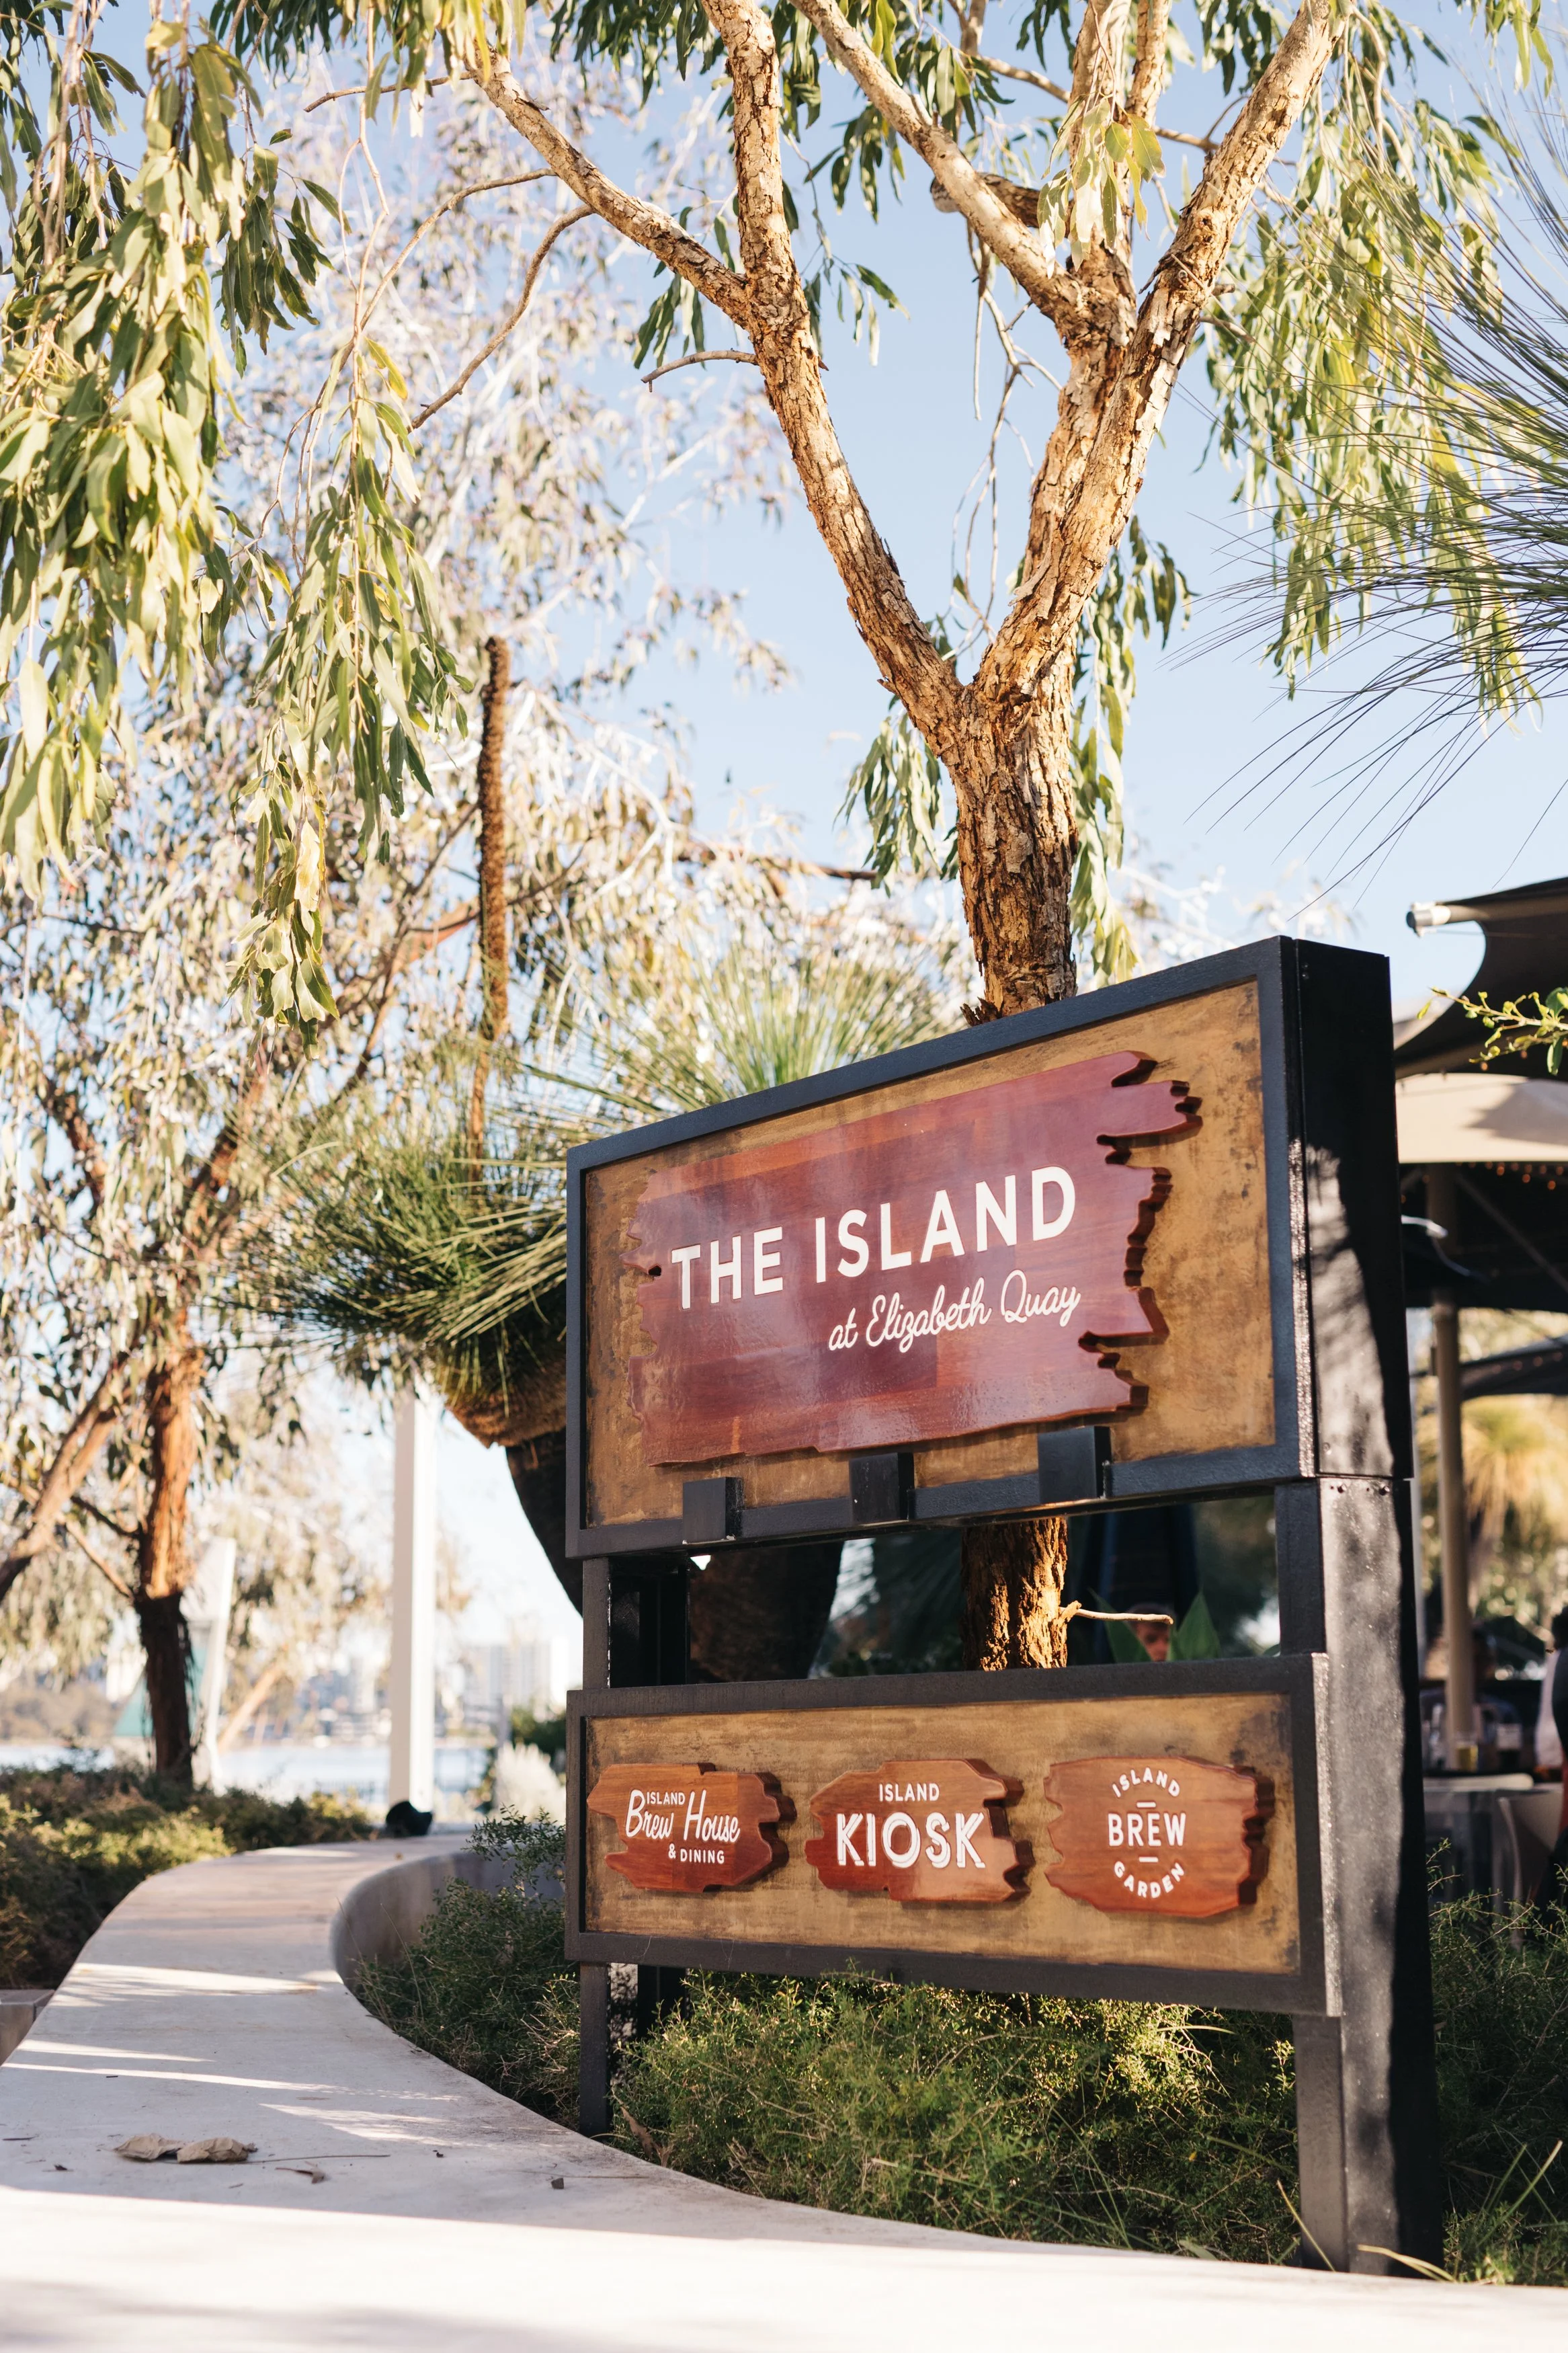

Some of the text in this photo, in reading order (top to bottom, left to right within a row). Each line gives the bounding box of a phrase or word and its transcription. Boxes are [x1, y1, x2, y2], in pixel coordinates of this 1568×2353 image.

[671, 1166, 1076, 1310] THE ISLAND
[828, 1269, 1081, 1353] at Elizabeth Quay
[646, 1791, 686, 1805] ISLAND
[878, 1783, 940, 1802] ISLAND
[1112, 1767, 1180, 1798] ISLAND
[625, 1789, 741, 1843] Brew House
[1108, 1812, 1186, 1847] BREW
[668, 1843, 725, 1864] & DINING
[837, 1811, 986, 1869] KIOSK
[1114, 1861, 1185, 1899] GARDEN
